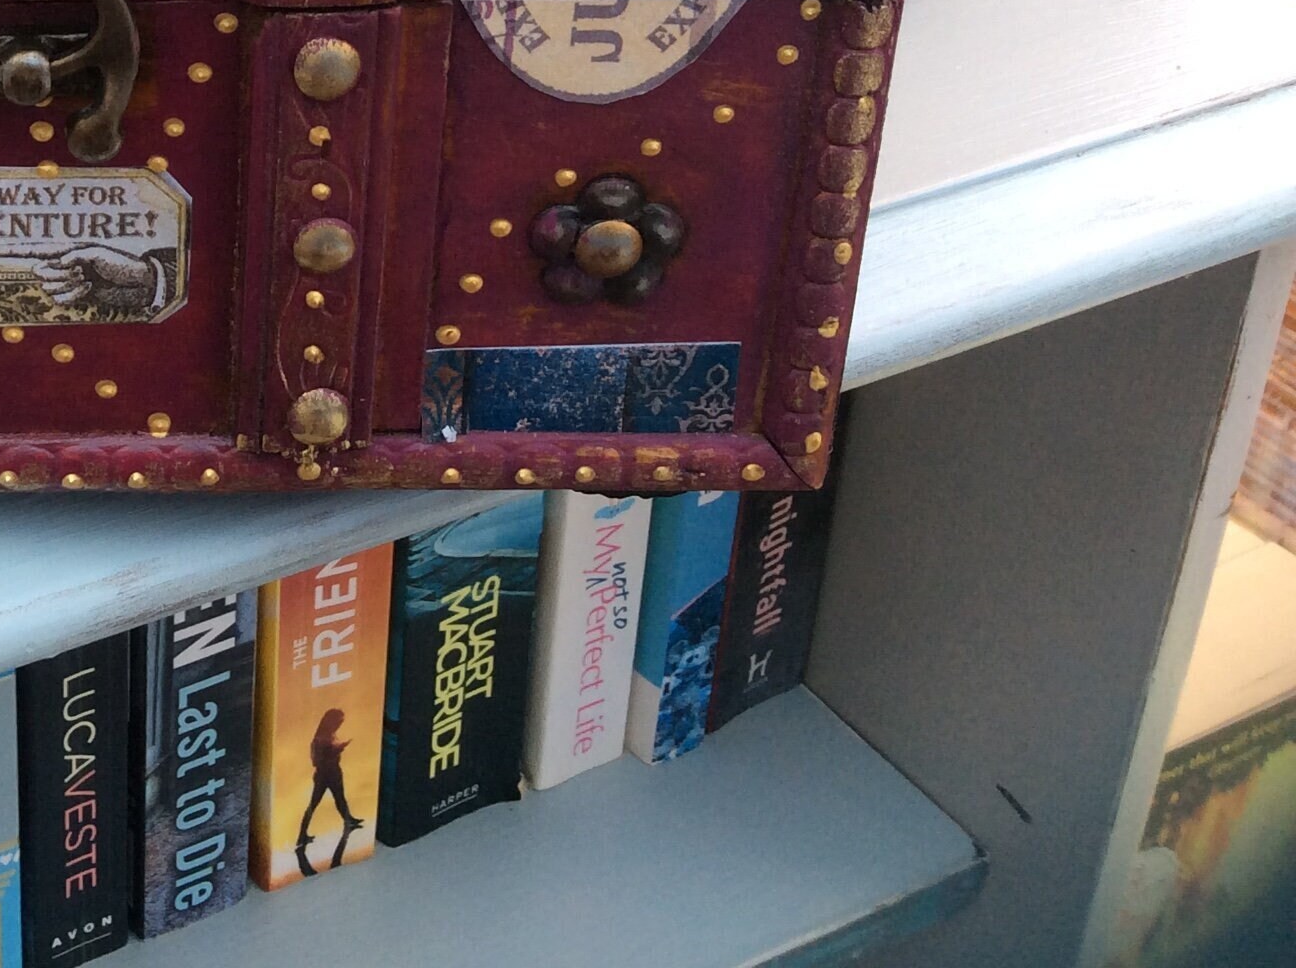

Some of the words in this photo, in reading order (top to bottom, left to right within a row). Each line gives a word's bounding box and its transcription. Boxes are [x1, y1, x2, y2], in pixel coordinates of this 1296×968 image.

[71, 186, 128, 207] FOR
[582, 523, 625, 575] My
[612, 562, 630, 601] not
[465, 575, 501, 699] STUART
[580, 585, 618, 696] Perfect
[612, 605, 628, 630] so
[292, 635, 308, 670] THE
[429, 585, 472, 779] MACBRIDE
[176, 671, 231, 779] Last
[572, 699, 605, 757] Life
[175, 777, 226, 831] to
[432, 783, 479, 814] HARPER
[175, 833, 226, 912] Die
[52, 915, 113, 949] AVON
